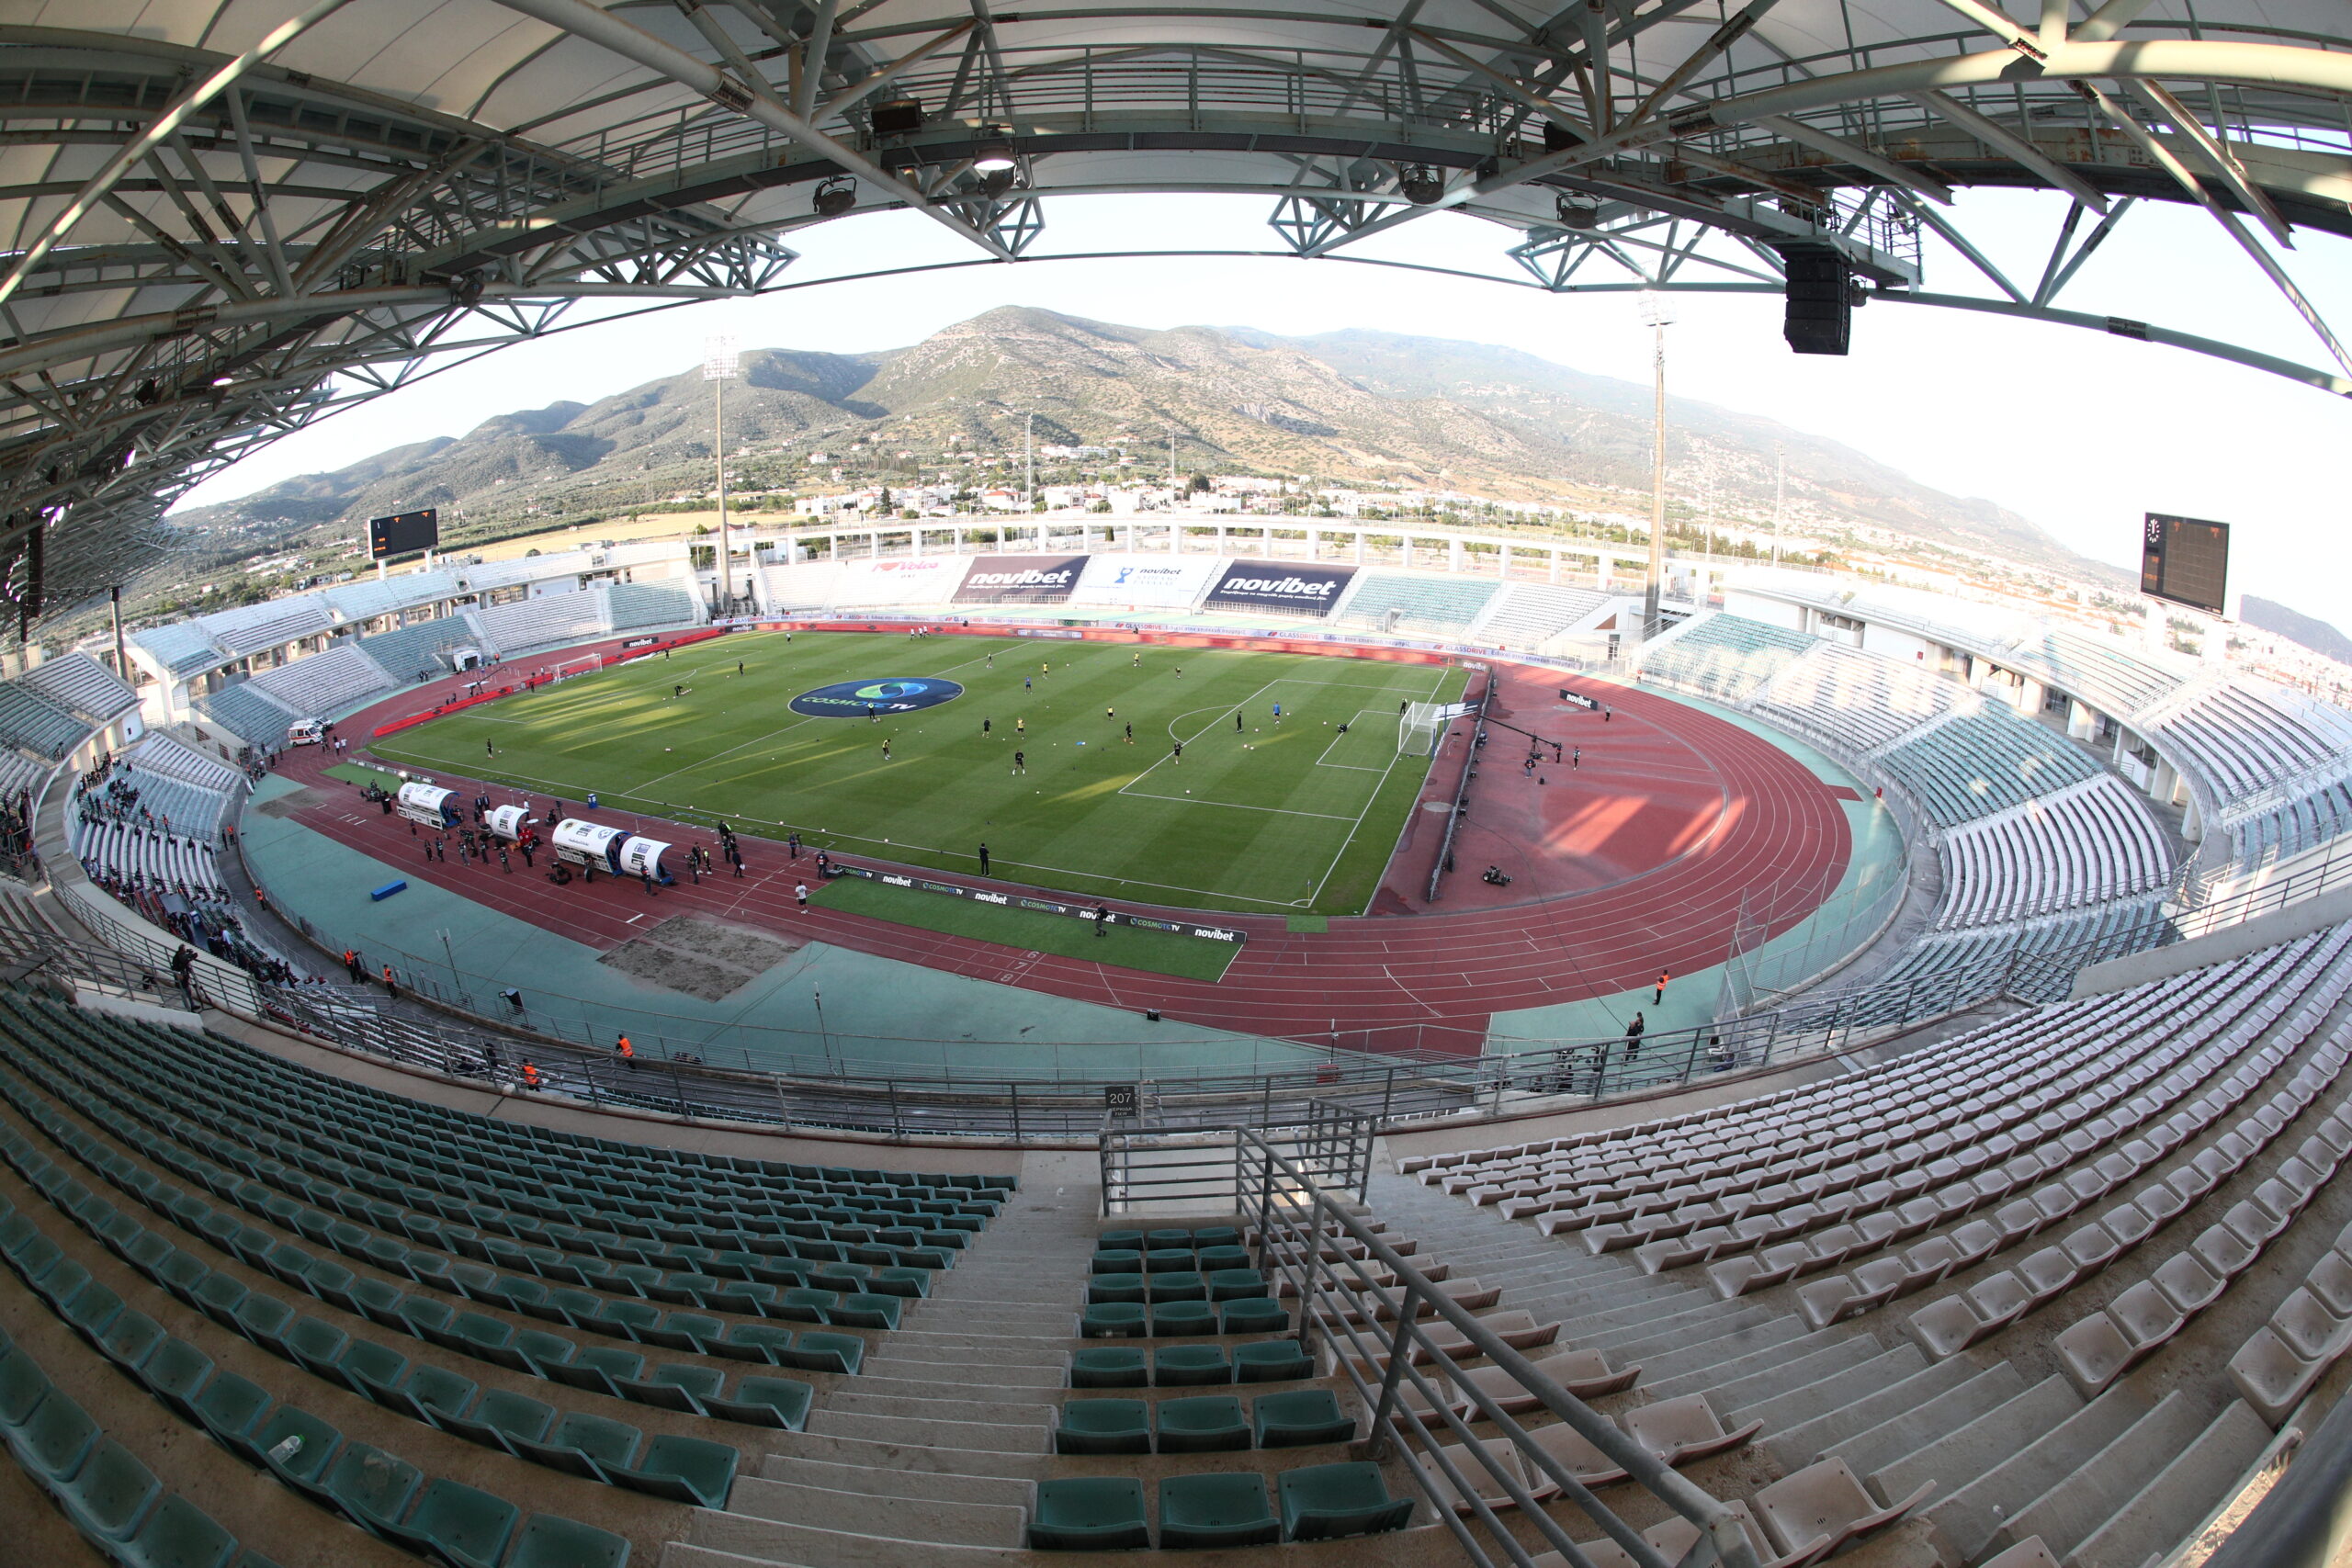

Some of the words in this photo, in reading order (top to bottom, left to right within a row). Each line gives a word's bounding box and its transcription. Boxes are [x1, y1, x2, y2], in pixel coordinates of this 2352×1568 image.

[968, 570, 1072, 584] novibet
[1140, 568, 1182, 576] novibet
[1224, 577, 1337, 595] novibet
[1279, 631, 1319, 640] GLASSDRIVE
[629, 637, 652, 648] novibet
[1446, 644, 1487, 655] GLASSDRIVE
[1566, 694, 1592, 709] novibet
[882, 875, 911, 887] novibet
[975, 893, 1008, 905] novibet
[1080, 909, 1115, 923] novet
[1194, 928, 1234, 942] novibet
[1027, 951, 1040, 959] 6
[1014, 962, 1028, 970] 7
[1001, 974, 1013, 982] 8
[1110, 1093, 1131, 1103] 207
